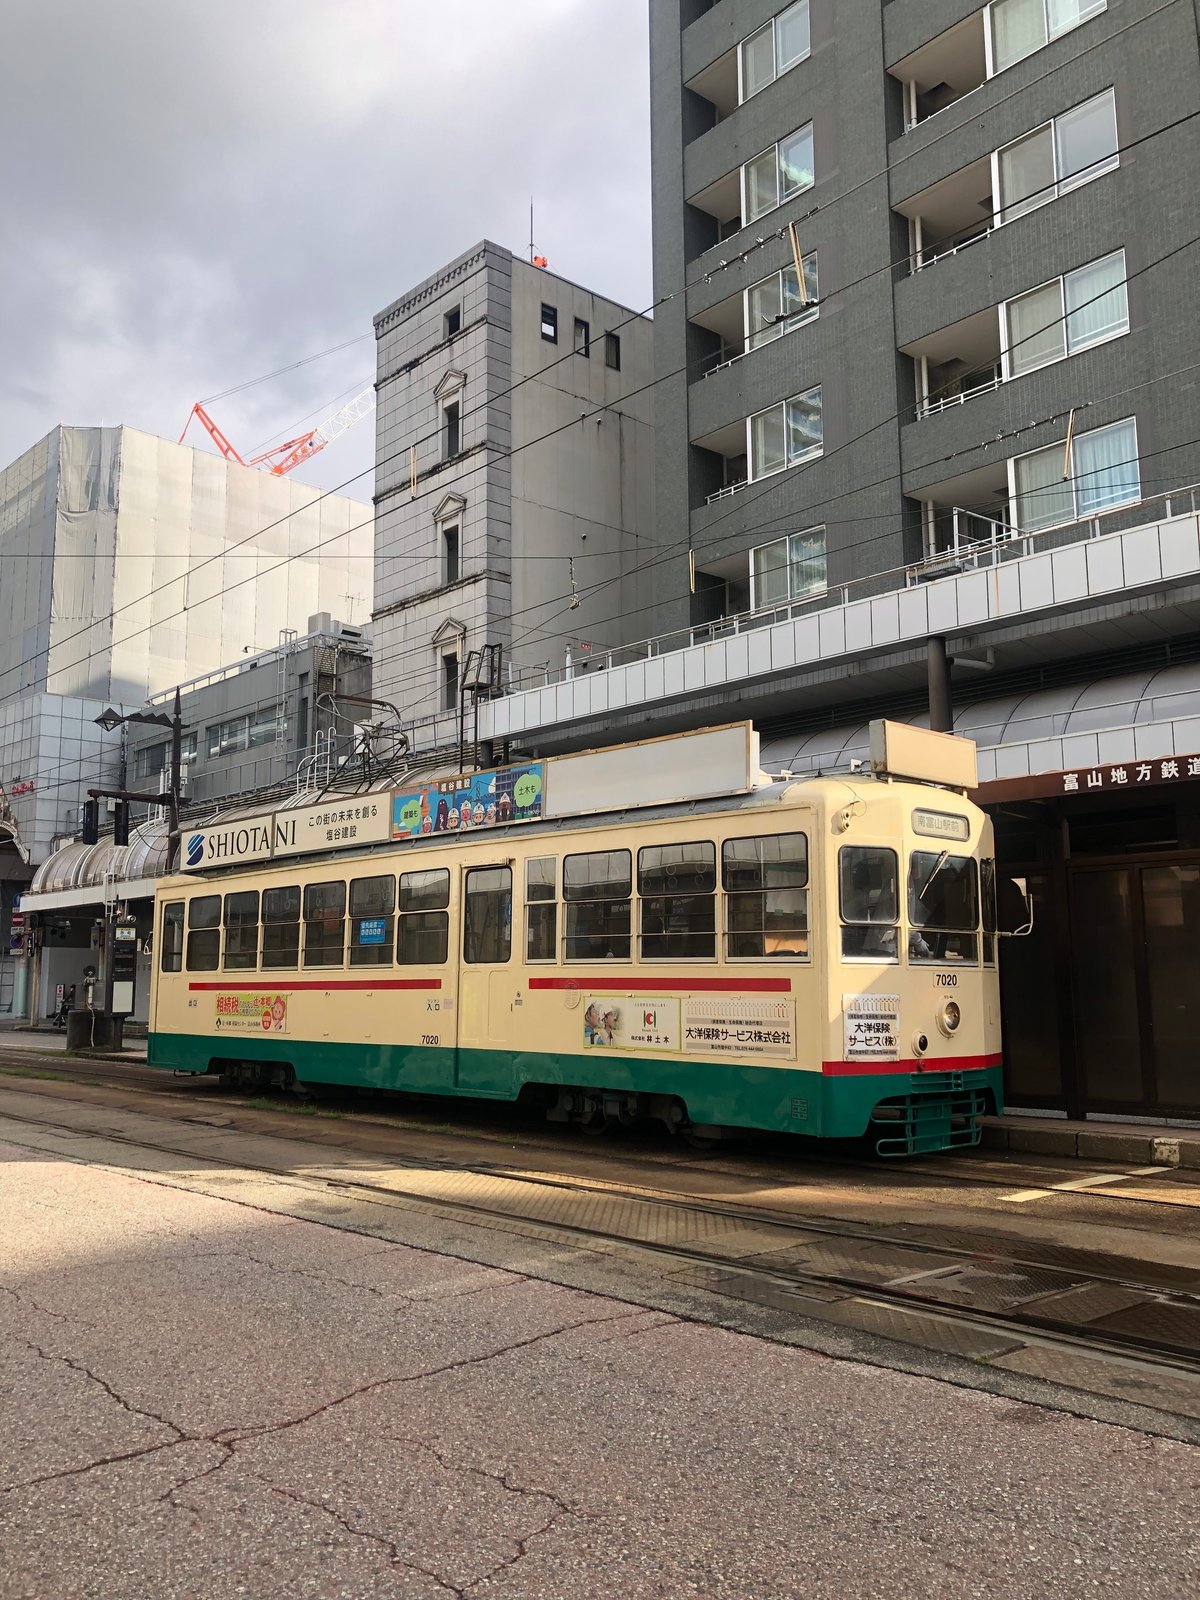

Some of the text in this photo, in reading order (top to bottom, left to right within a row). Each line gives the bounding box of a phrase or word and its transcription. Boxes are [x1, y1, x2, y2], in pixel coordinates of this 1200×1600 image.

[1063, 757, 1200, 791] 富山地方鉄道
[518, 785, 536, 796] 土木も
[308, 805, 378, 827] この街の未来を創る
[918, 815, 959, 832] 南富山駅前
[207, 820, 297, 859] SHIOTANI
[326, 825, 357, 841] 塩谷建設
[936, 974, 957, 986] 7020
[216, 996, 239, 1013] 相続税
[427, 1003, 440, 1011] 入口
[685, 1027, 791, 1044] 大洋保険サービス株式会社
[854, 1023, 890, 1033] 大洋保険
[421, 1035, 439, 1045] 7020
[849, 1035, 897, 1047] サービス(株)
